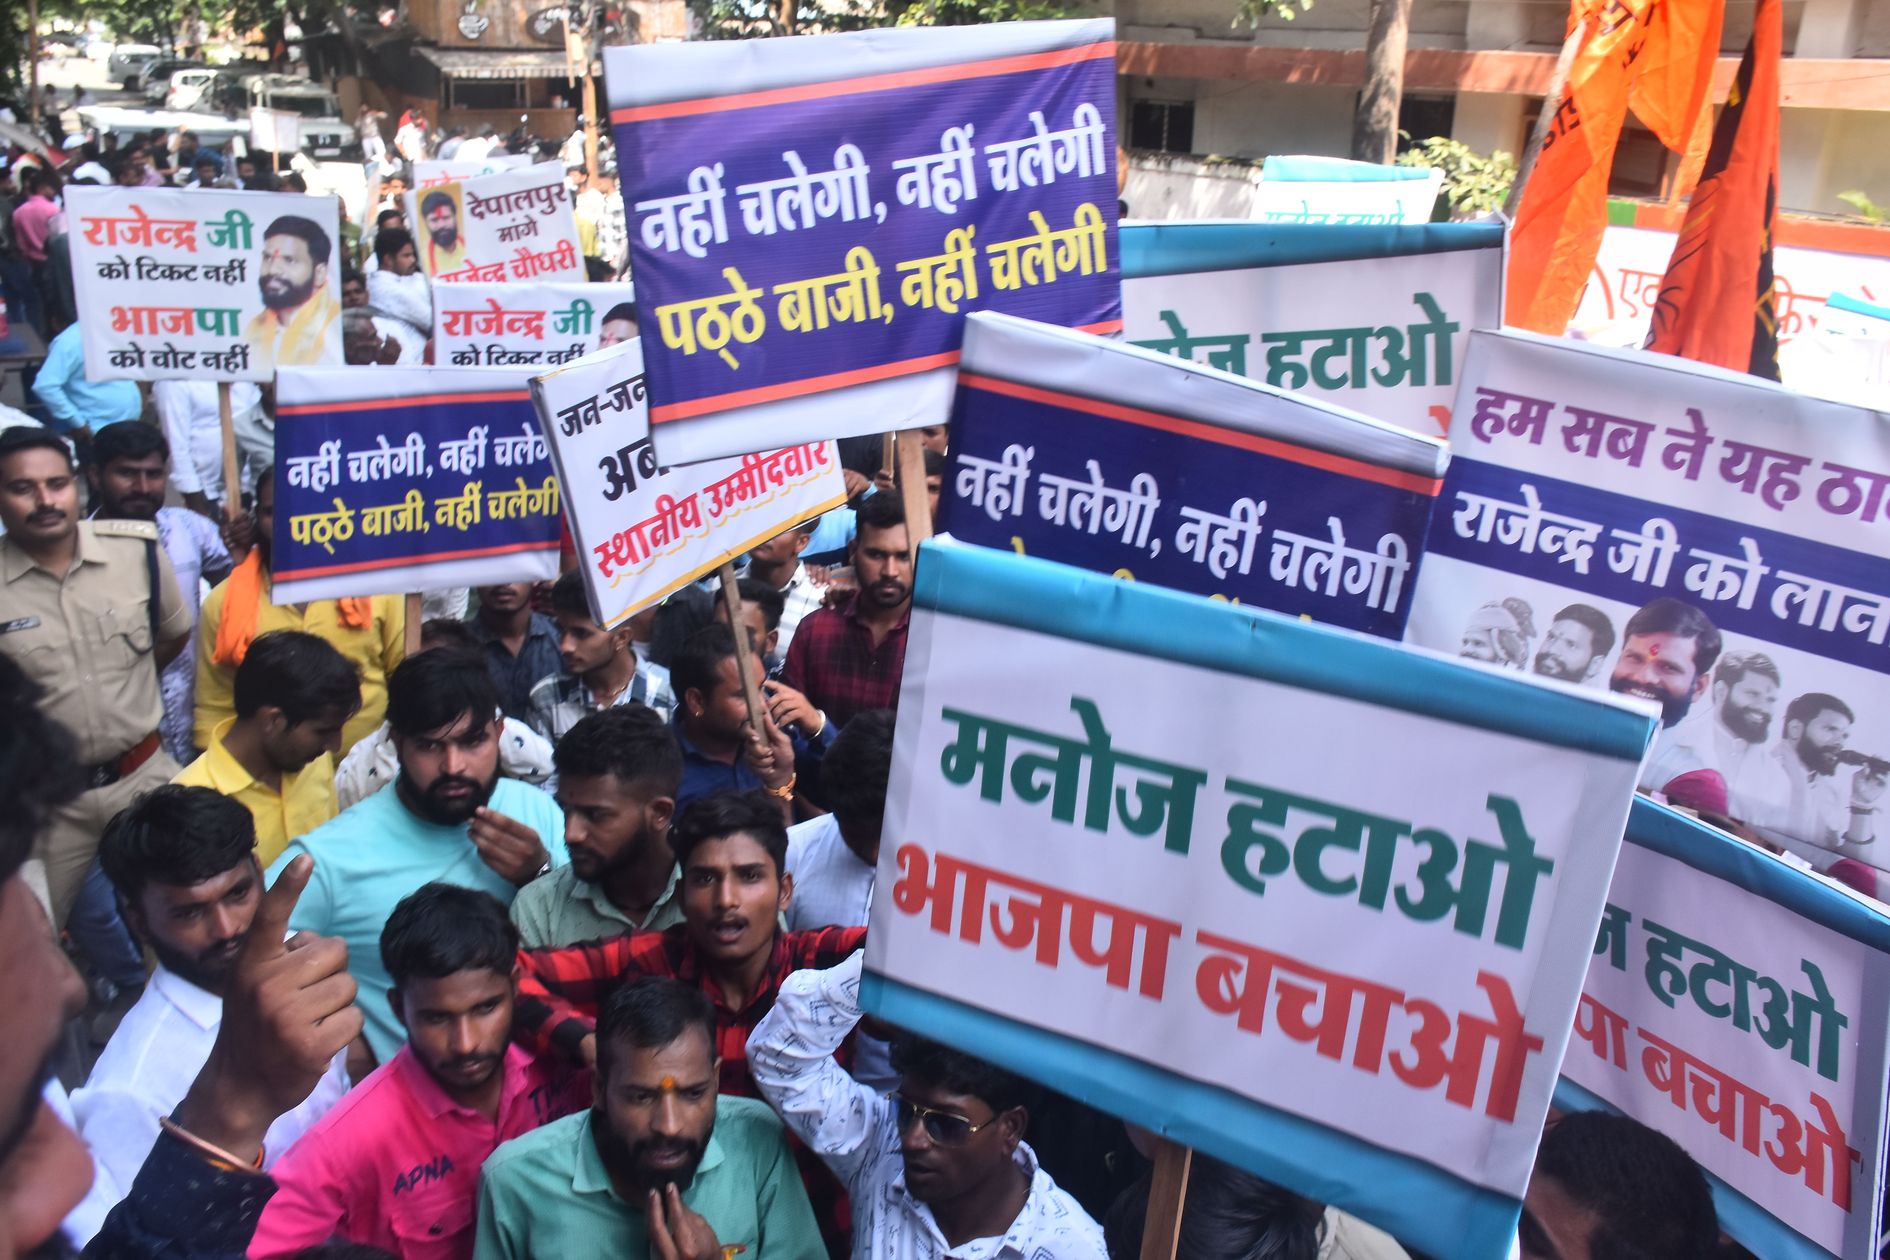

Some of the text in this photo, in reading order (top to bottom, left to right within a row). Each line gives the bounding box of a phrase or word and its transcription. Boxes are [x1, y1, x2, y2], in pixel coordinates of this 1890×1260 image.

[466, 182, 568, 220] देपालपुर
[635, 102, 1107, 258] नहीं चलेगी, नहीं चलेगी
[81, 204, 254, 252] राजेन्द्र जी
[496, 214, 539, 243] मांगे
[509, 239, 577, 279] चौधरी
[97, 255, 246, 285] को टिकट नहीं
[773, 246, 894, 334] बाजी,
[896, 224, 977, 313] नहीं
[987, 203, 1108, 292] चलेगी
[110, 305, 242, 336] भाजपा
[442, 298, 595, 340] राजेन्द्र जी
[1262, 292, 1461, 390] हटाओ
[109, 342, 249, 373] को वोट नहीं
[450, 344, 481, 366] को
[487, 343, 542, 365] टिकट
[286, 439, 341, 493] नहीं
[439, 424, 489, 476] नहीं
[1470, 387, 1555, 444] हम
[1560, 405, 1656, 468] सब
[1661, 408, 1714, 481] ने
[1718, 440, 1812, 511] यह
[434, 480, 482, 531] नहीं
[487, 475, 560, 520] चलेगी
[593, 441, 829, 578] स्थानीय उम्मीदवार
[955, 443, 1035, 522] नहीं
[1175, 497, 1267, 580] नहीं
[1270, 516, 1411, 614] चलेगी
[1452, 484, 1603, 575] राजेन्द्र
[1607, 516, 1681, 588] जी
[1684, 537, 1770, 610] को
[940, 695, 1207, 858] मनोज
[1220, 776, 1555, 952] हटाओ
[891, 842, 1182, 1002] भाजपा
[1195, 929, 1544, 1127] बचाओ
[1642, 918, 1849, 1083] हटाओ
[1637, 1027, 1861, 1214] बचाओ
[393, 1154, 454, 1196] APNA
